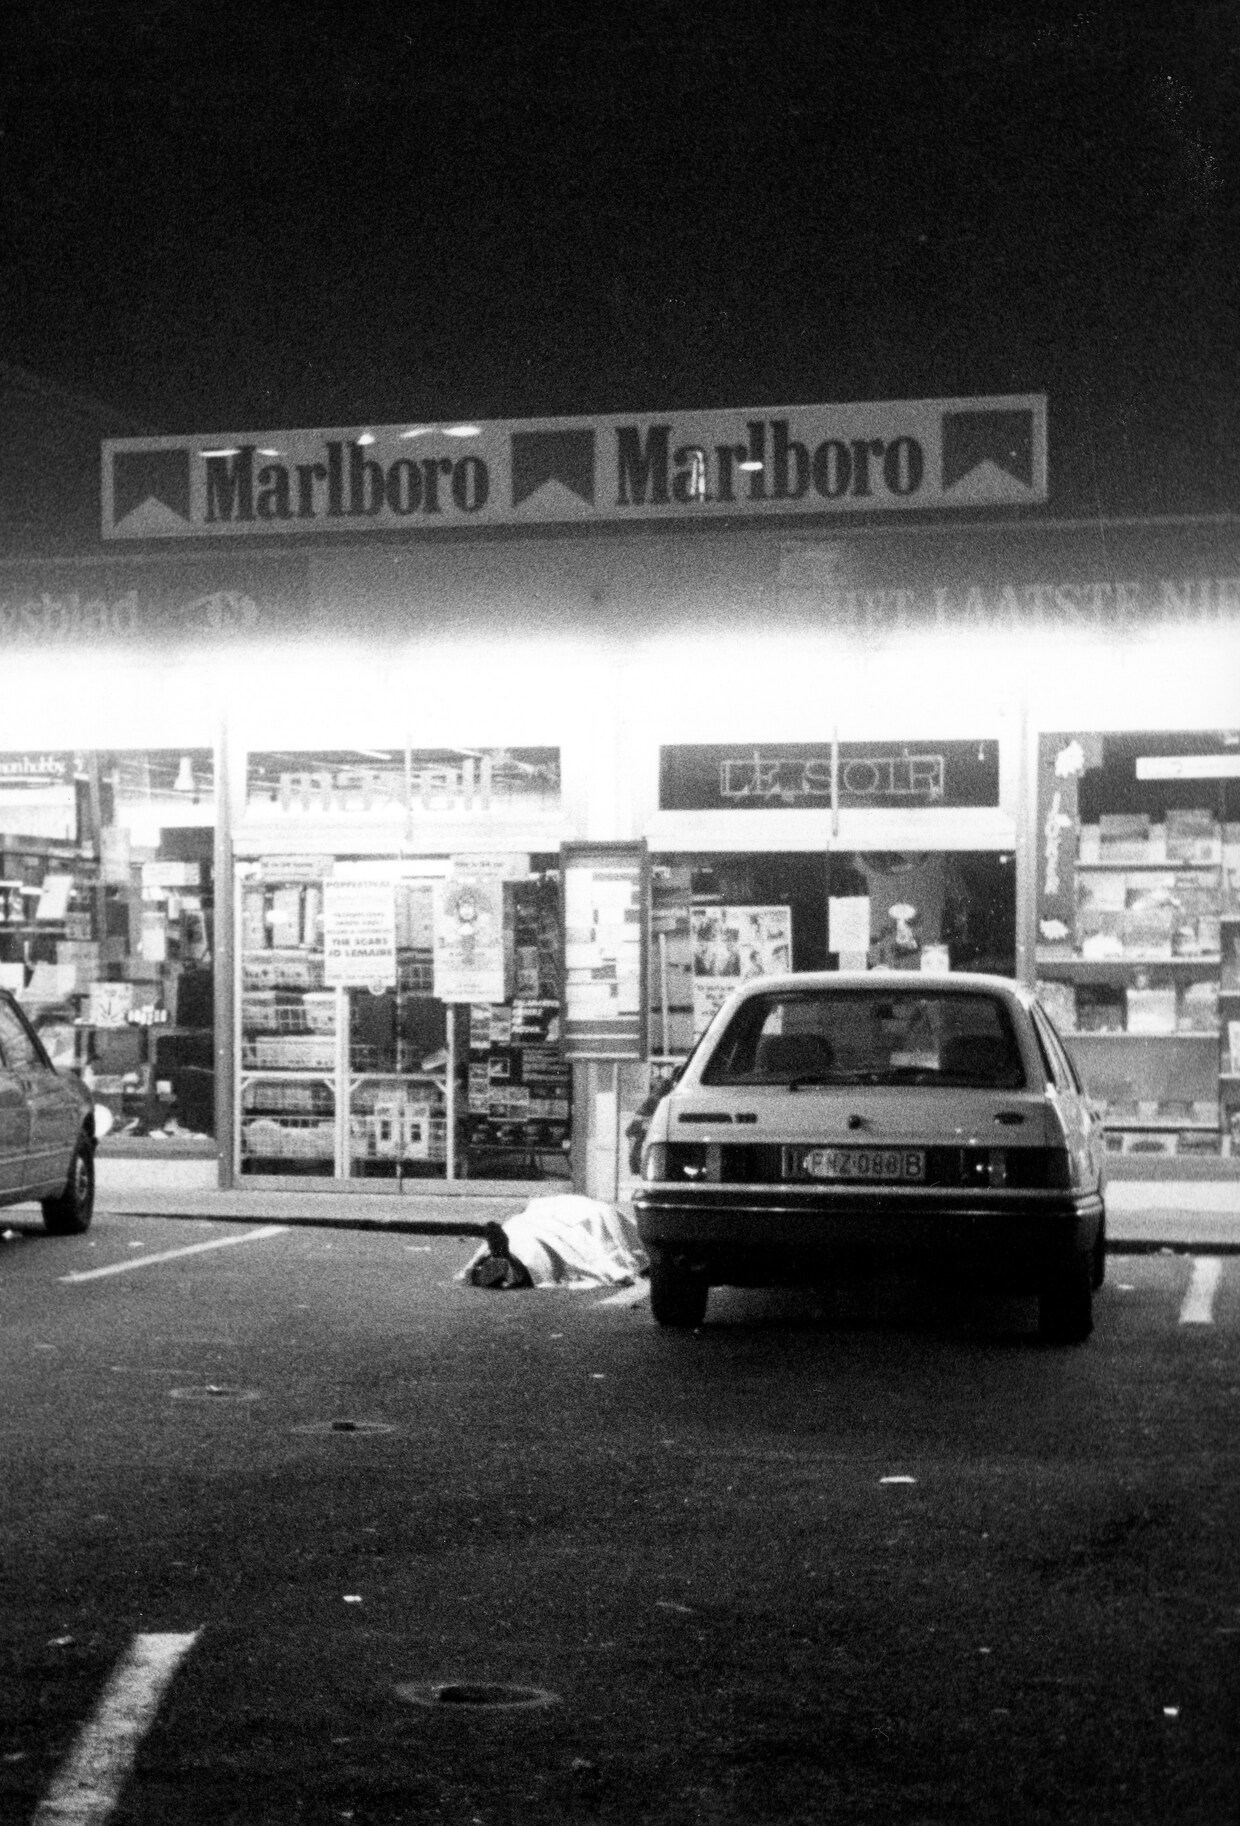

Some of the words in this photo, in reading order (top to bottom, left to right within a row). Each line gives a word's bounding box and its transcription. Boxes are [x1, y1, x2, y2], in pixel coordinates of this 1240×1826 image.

[203, 439, 491, 524] Marlboro
[614, 418, 925, 508] Marlboro
[723, 760, 782, 795] LE
[801, 756, 941, 796] SOIR
